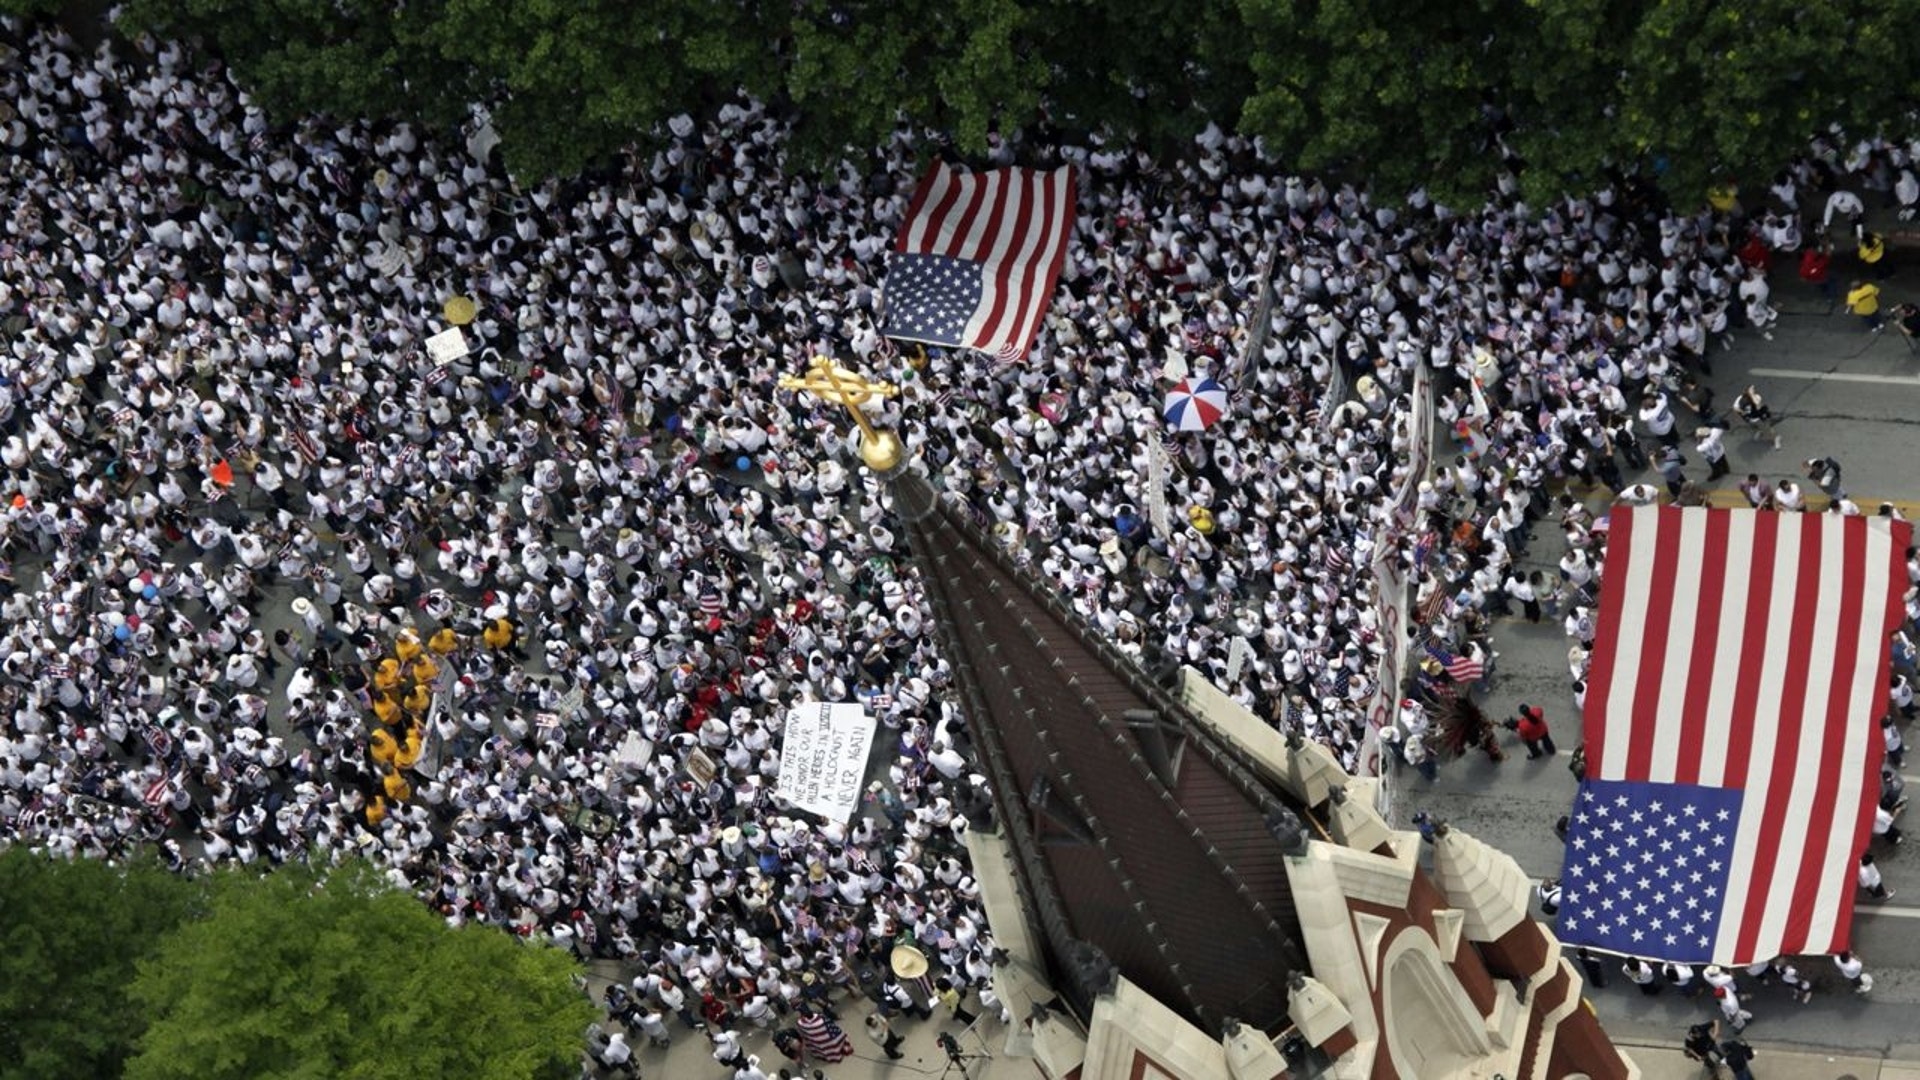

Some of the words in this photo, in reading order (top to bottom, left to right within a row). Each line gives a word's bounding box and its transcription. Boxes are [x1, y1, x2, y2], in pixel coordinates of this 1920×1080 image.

[788, 713, 801, 739] HOW
[800, 729, 814, 751] OUR
[818, 734, 829, 746] IN
[848, 726, 865, 761] AGAIN
[784, 745, 796, 769] THIS
[811, 749, 826, 780] HEROES
[825, 727, 845, 788] HOLOCAUST
[781, 774, 793, 792] IS
[798, 757, 809, 785] HONOR
[795, 787, 806, 802] WE
[807, 782, 819, 804] FALLEN
[821, 793, 832, 802] A
[838, 770, 860, 808] NEVER
